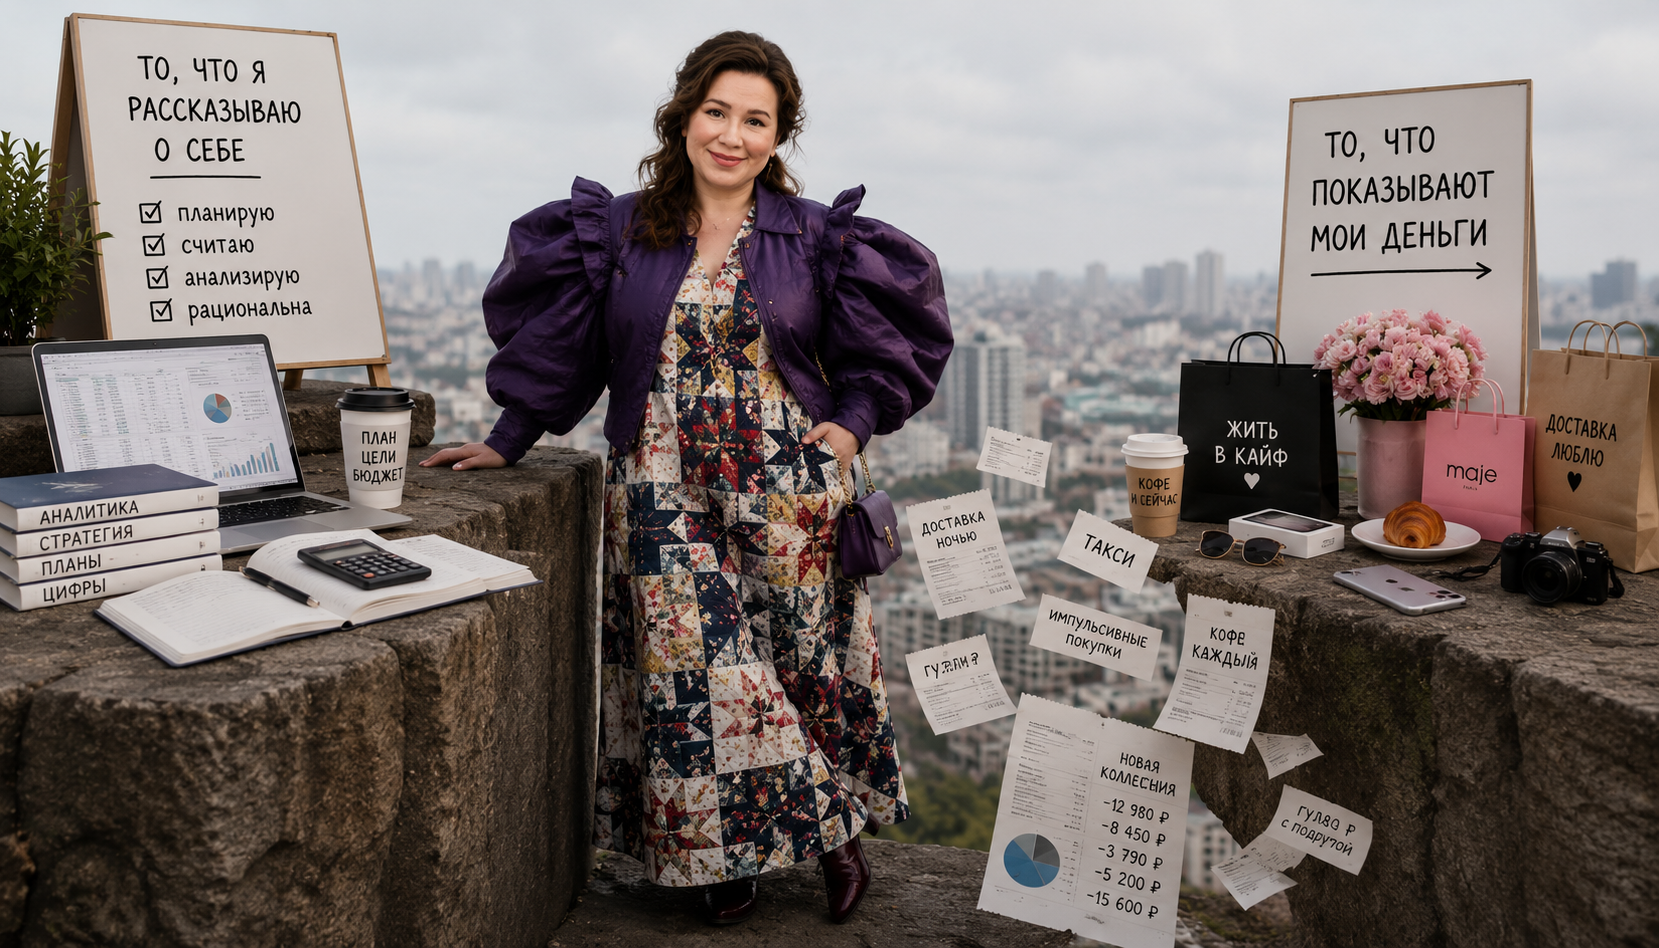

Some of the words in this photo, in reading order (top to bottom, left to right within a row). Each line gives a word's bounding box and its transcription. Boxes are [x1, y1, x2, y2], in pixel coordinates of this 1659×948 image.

[137, 56, 178, 85] ТО,
[193, 58, 238, 83] ЧТО
[252, 61, 266, 84] Я
[128, 96, 302, 124] РАССКАЗЫВАЮ
[154, 138, 170, 162] О
[186, 138, 245, 162] СЕБЕ
[1325, 131, 1366, 162] ТО,
[1385, 126, 1435, 155] ЧТО
[1312, 170, 1495, 206] ПОКАЗЫВАЮТ
[178, 206, 275, 228] планирую
[181, 238, 255, 255] считаю
[1311, 224, 1366, 252] МОИ
[1381, 219, 1487, 254] ДЕНЬГИ
[185, 269, 300, 291] анализирую
[187, 300, 312, 325] рациональна
[361, 430, 397, 445] ПЛАН
[1227, 420, 1279, 440] ЖИТЬ
[1546, 414, 1617, 442] ДОСТАВКА
[361, 450, 396, 466] ЦЕЛИ
[1215, 445, 1226, 464] В
[1235, 444, 1288, 467] КАЙФ
[1551, 443, 1604, 467] ЛЮБЛЮ
[353, 467, 403, 485] БЮДЖЕТ
[1138, 478, 1170, 491] КОФЕ
[1446, 464, 1498, 485] maje
[1131, 493, 1138, 504] И
[1140, 493, 1178, 506] СЕЙЧАС
[40, 500, 139, 525] АНАЛИТИКА
[921, 511, 986, 537] ДОСТАВКА
[40, 525, 133, 551] СТРАТЕГИЯ
[936, 531, 977, 549] НОЧЬЮ
[1084, 533, 1135, 568] ТАКСИ
[42, 554, 101, 576] ПЛАНЫ
[43, 578, 106, 603] ЦИФРЫ
[1048, 609, 1149, 649] ИМПУЛЬСИВНЫЕ
[1210, 626, 1246, 646] КОФЕ
[1065, 633, 1122, 660] ПОКУПКИ
[1119, 752, 1160, 774] НОВАЯ
[1130, 803, 1154, 821] 980
[1124, 825, 1151, 844] 450
[1122, 848, 1147, 867] 790
[1117, 871, 1145, 891] 200
[1115, 896, 1143, 916] 600
